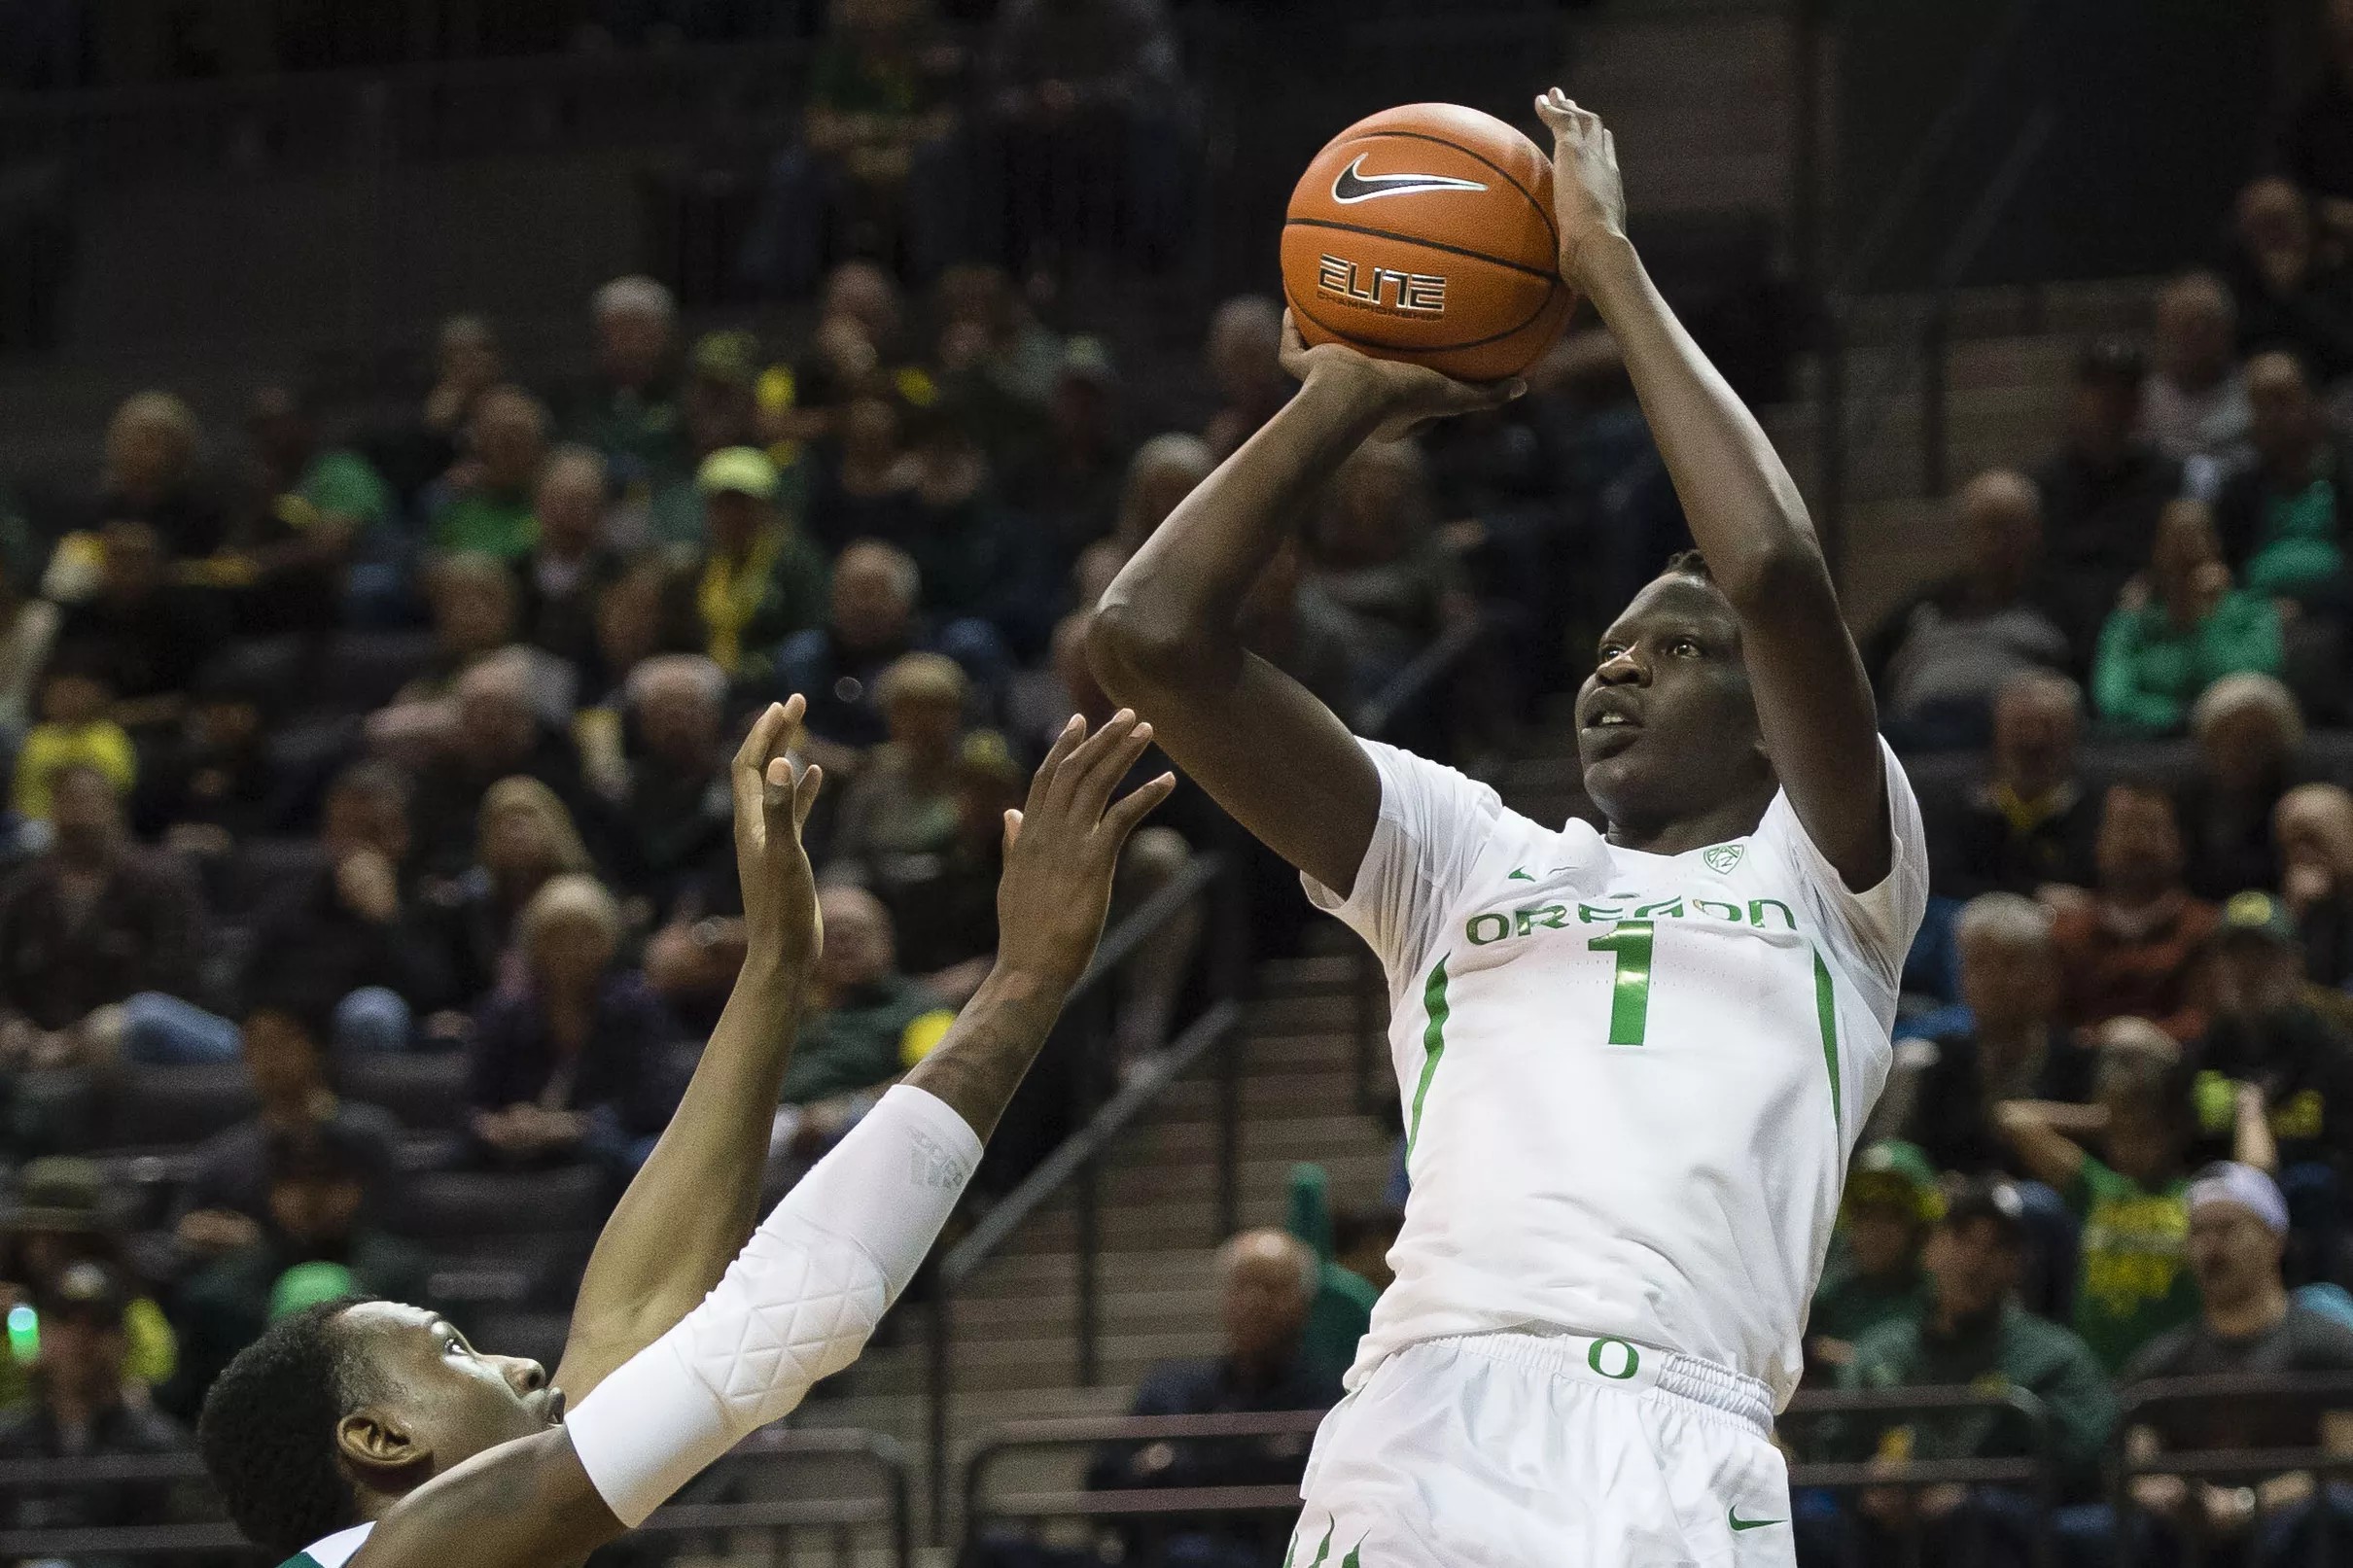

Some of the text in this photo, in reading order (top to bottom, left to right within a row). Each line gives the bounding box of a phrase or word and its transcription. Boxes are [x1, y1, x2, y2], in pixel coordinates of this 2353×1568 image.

[1317, 253, 1447, 312] ELITE
[1588, 920, 1654, 1046] 1
[1588, 1338, 1640, 1379] O
